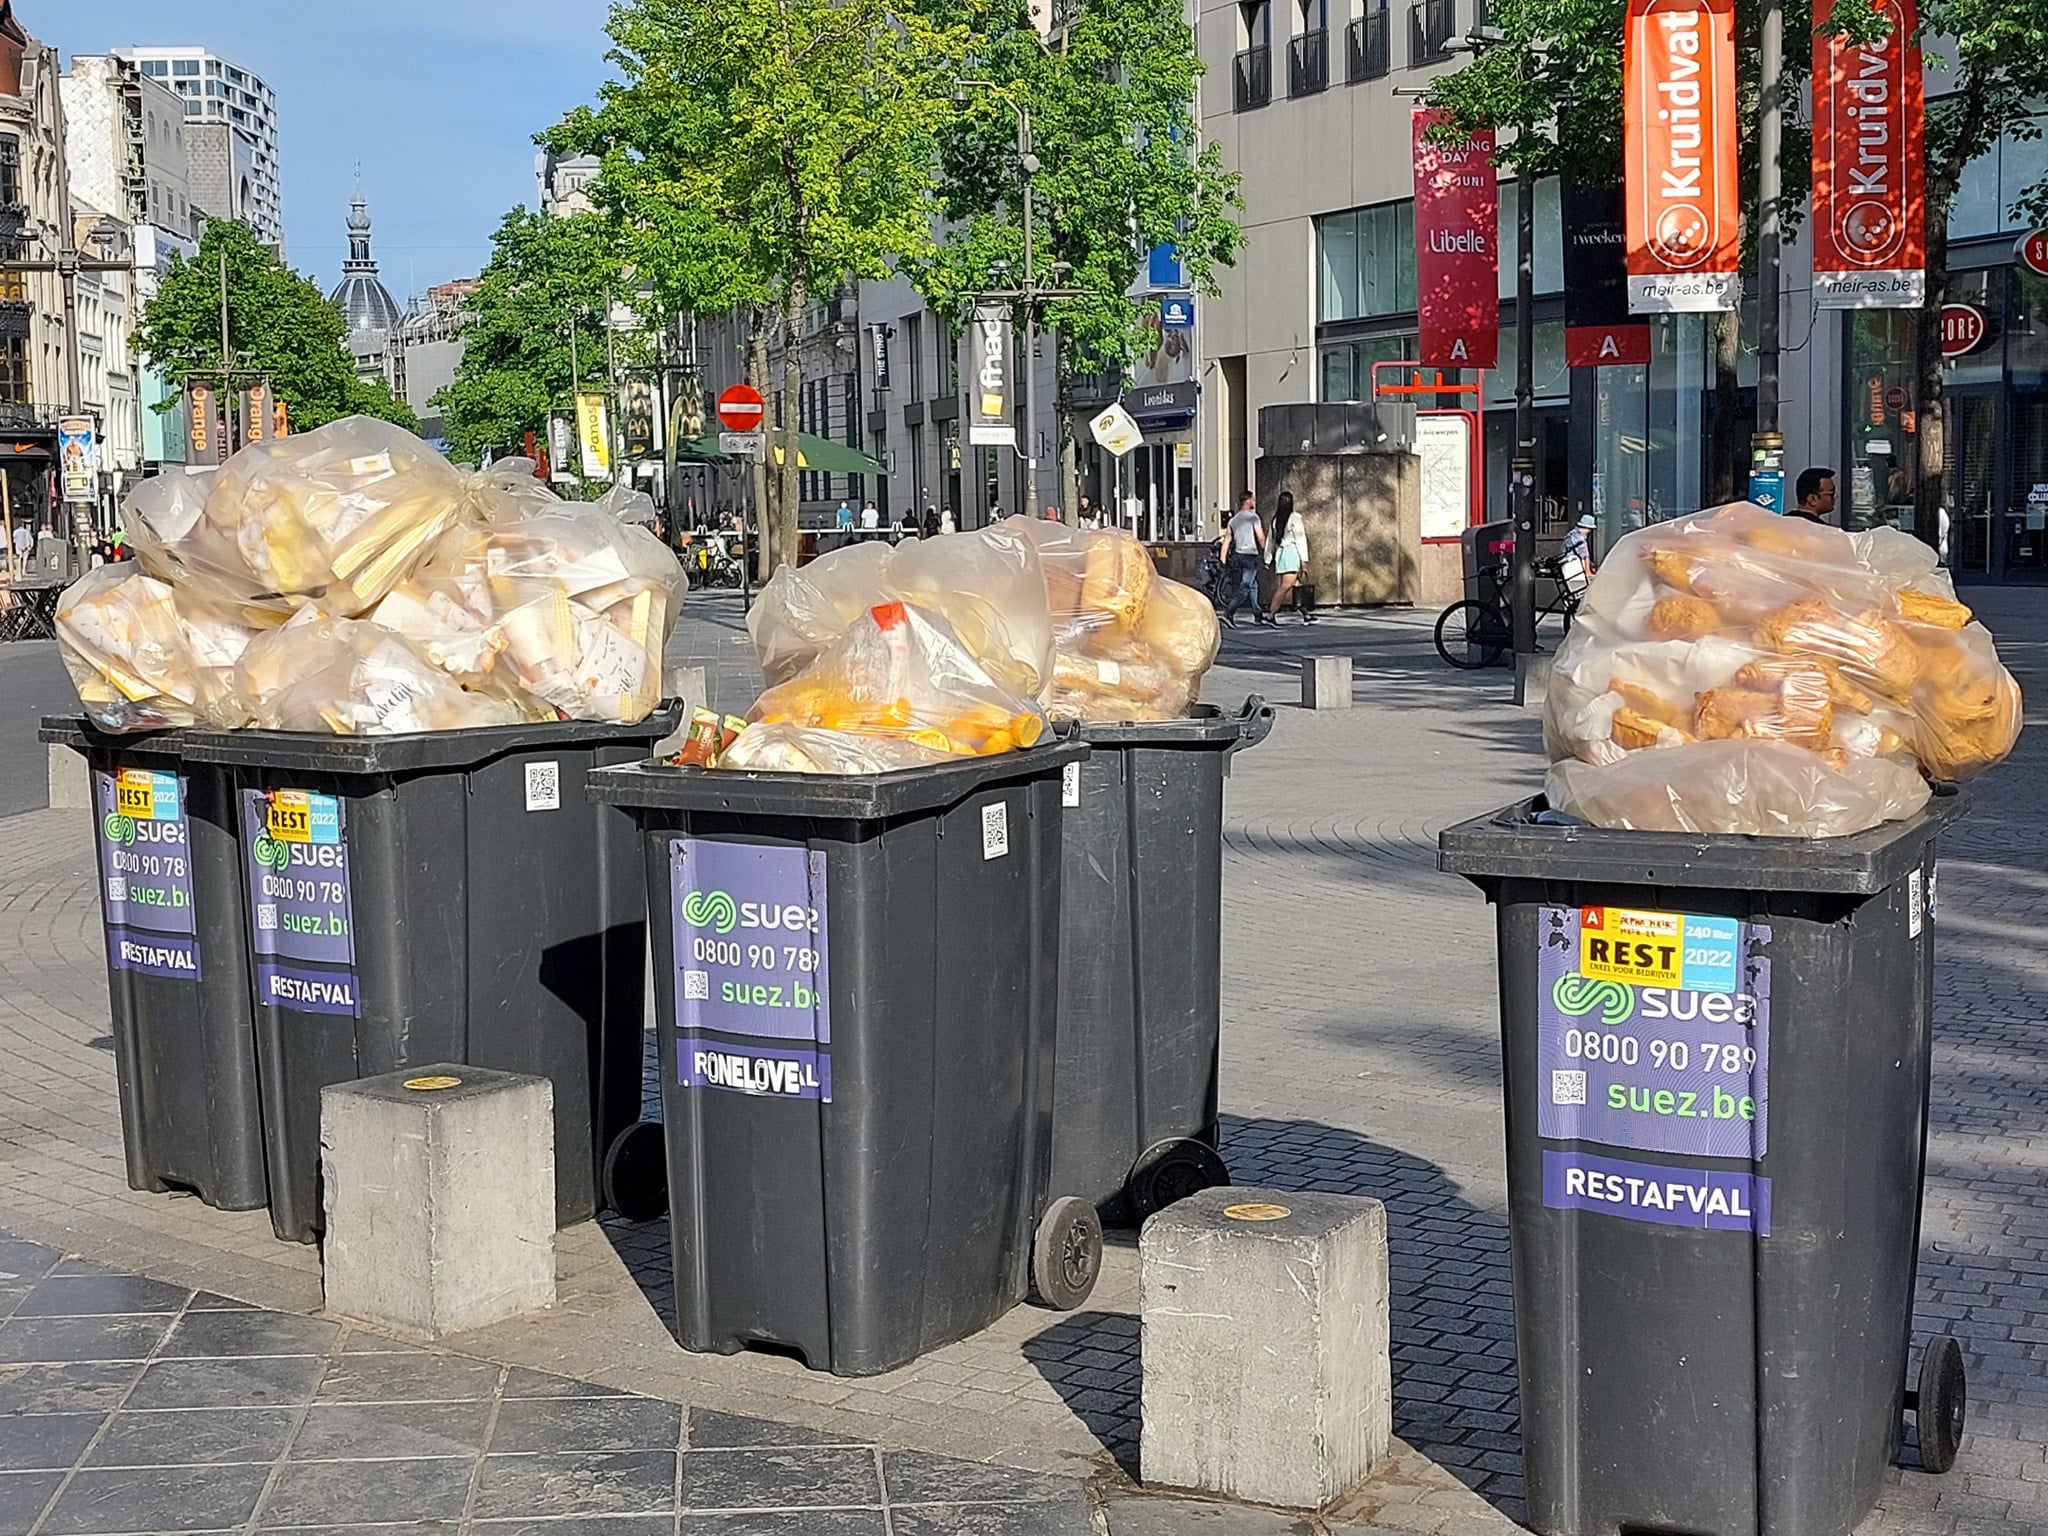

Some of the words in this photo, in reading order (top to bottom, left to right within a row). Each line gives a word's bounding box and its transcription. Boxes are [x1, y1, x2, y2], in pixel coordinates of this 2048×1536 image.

[1658, 9, 1701, 198] Kruidvat
[1443, 152, 1470, 163] DAY
[1430, 229, 1485, 253] Libelle
[1642, 279, 1725, 298] meir-as.be
[1827, 276, 1911, 294] meir-as.be
[980, 318, 1003, 389] fnac
[1450, 338, 1468, 360] A
[1599, 335, 1619, 357] A
[191, 387, 208, 451] Orange
[588, 408, 600, 453] Panos
[120, 788, 150, 806] REST
[153, 791, 176, 803] 2022
[272, 810, 307, 829] REST
[311, 813, 335, 825] 2022
[142, 856, 159, 875] 90
[164, 857, 188, 877] 78
[263, 875, 293, 899] 0800
[297, 880, 316, 902] 90
[320, 882, 346, 904] 78
[1586, 911, 1599, 925] A
[1684, 925, 1711, 939] 240
[120, 941, 196, 970] RESTAFVAL
[694, 938, 741, 966] 0800
[748, 945, 775, 970] 90
[1590, 938, 1676, 970] REST
[1684, 948, 1733, 967] 2022
[1590, 963, 1610, 972] ENKEL
[1613, 965, 1633, 975] VOOR
[1636, 968, 1677, 979] BEDRIJVEN
[270, 975, 355, 1005] RESTAFVAL
[1565, 1029, 1639, 1065] 0800
[1650, 1040, 1689, 1071] 90
[1701, 1043, 1757, 1075] 789
[1607, 1083, 1757, 1120] suez.be
[1566, 1168, 1751, 1217] RESTAFVAL
